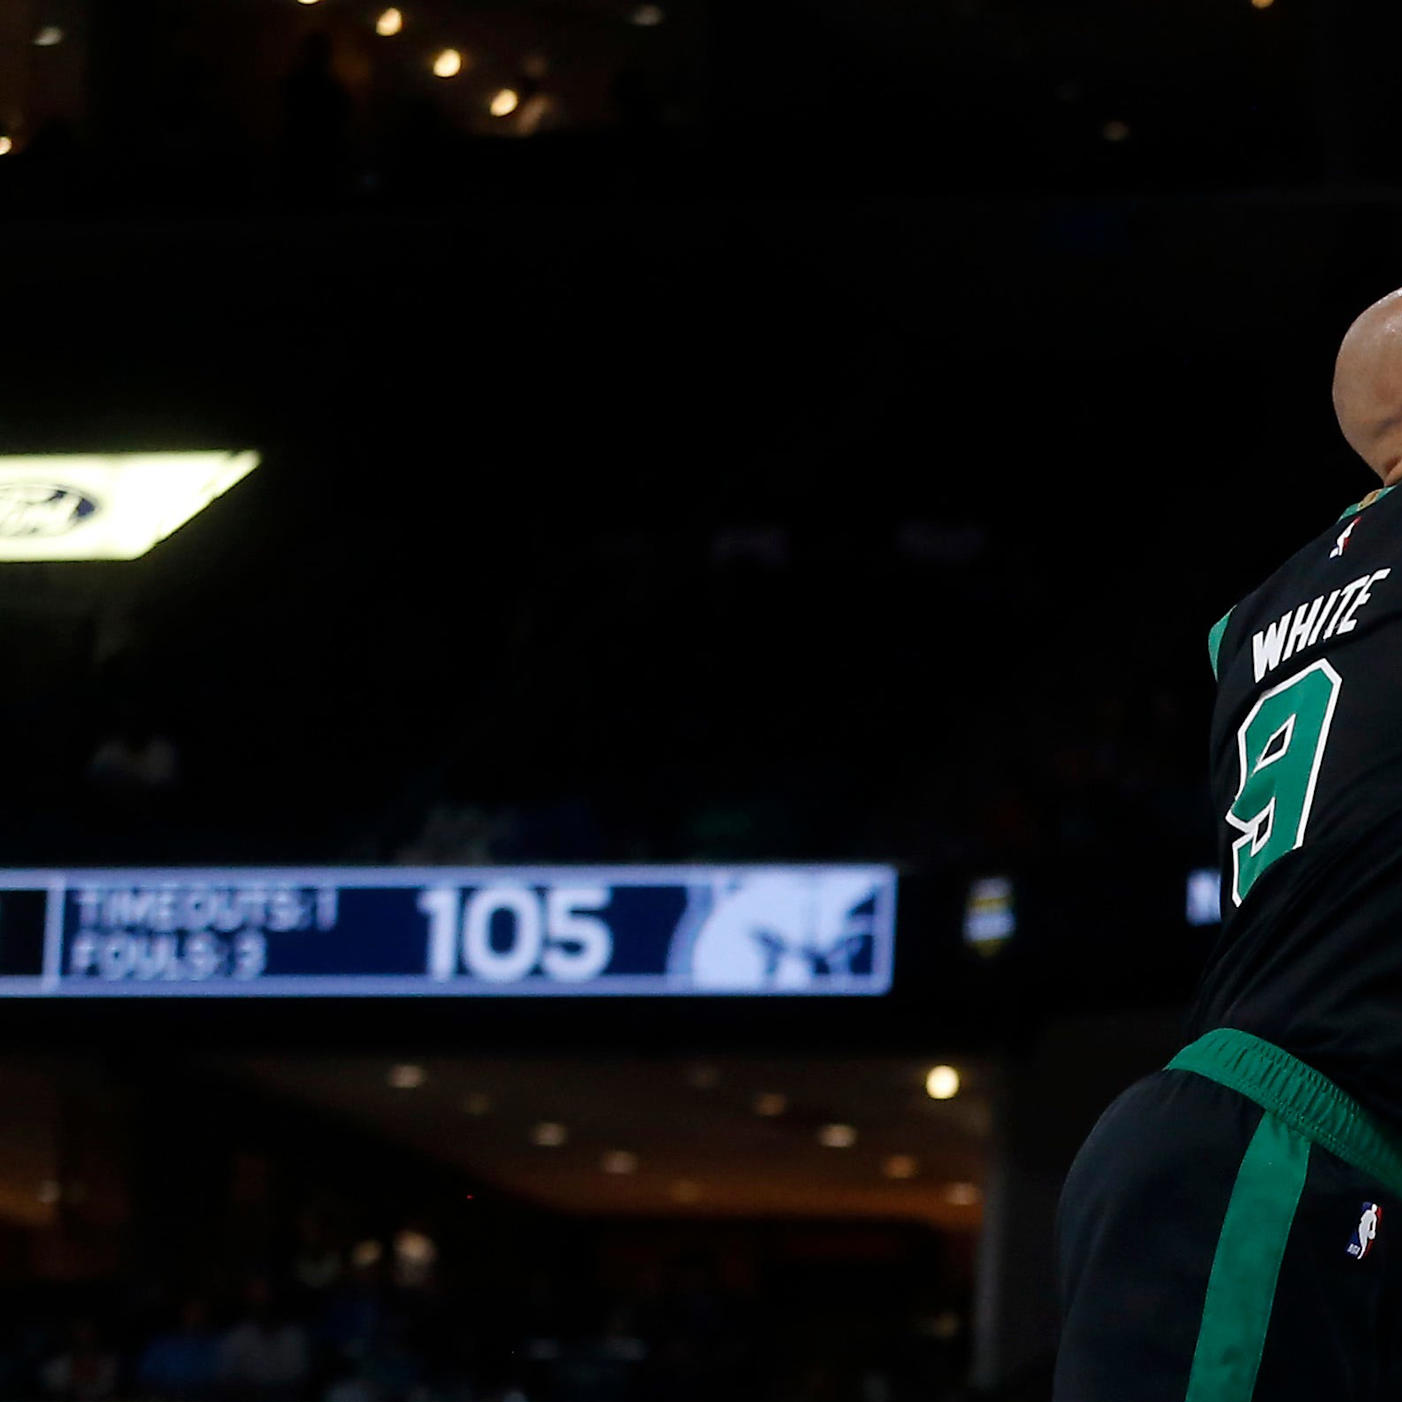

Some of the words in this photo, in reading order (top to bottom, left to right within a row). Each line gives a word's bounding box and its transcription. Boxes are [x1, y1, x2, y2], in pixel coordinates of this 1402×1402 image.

[1252, 568, 1391, 683] WHITE
[1225, 657, 1342, 908] 9
[416, 884, 614, 983] 105
